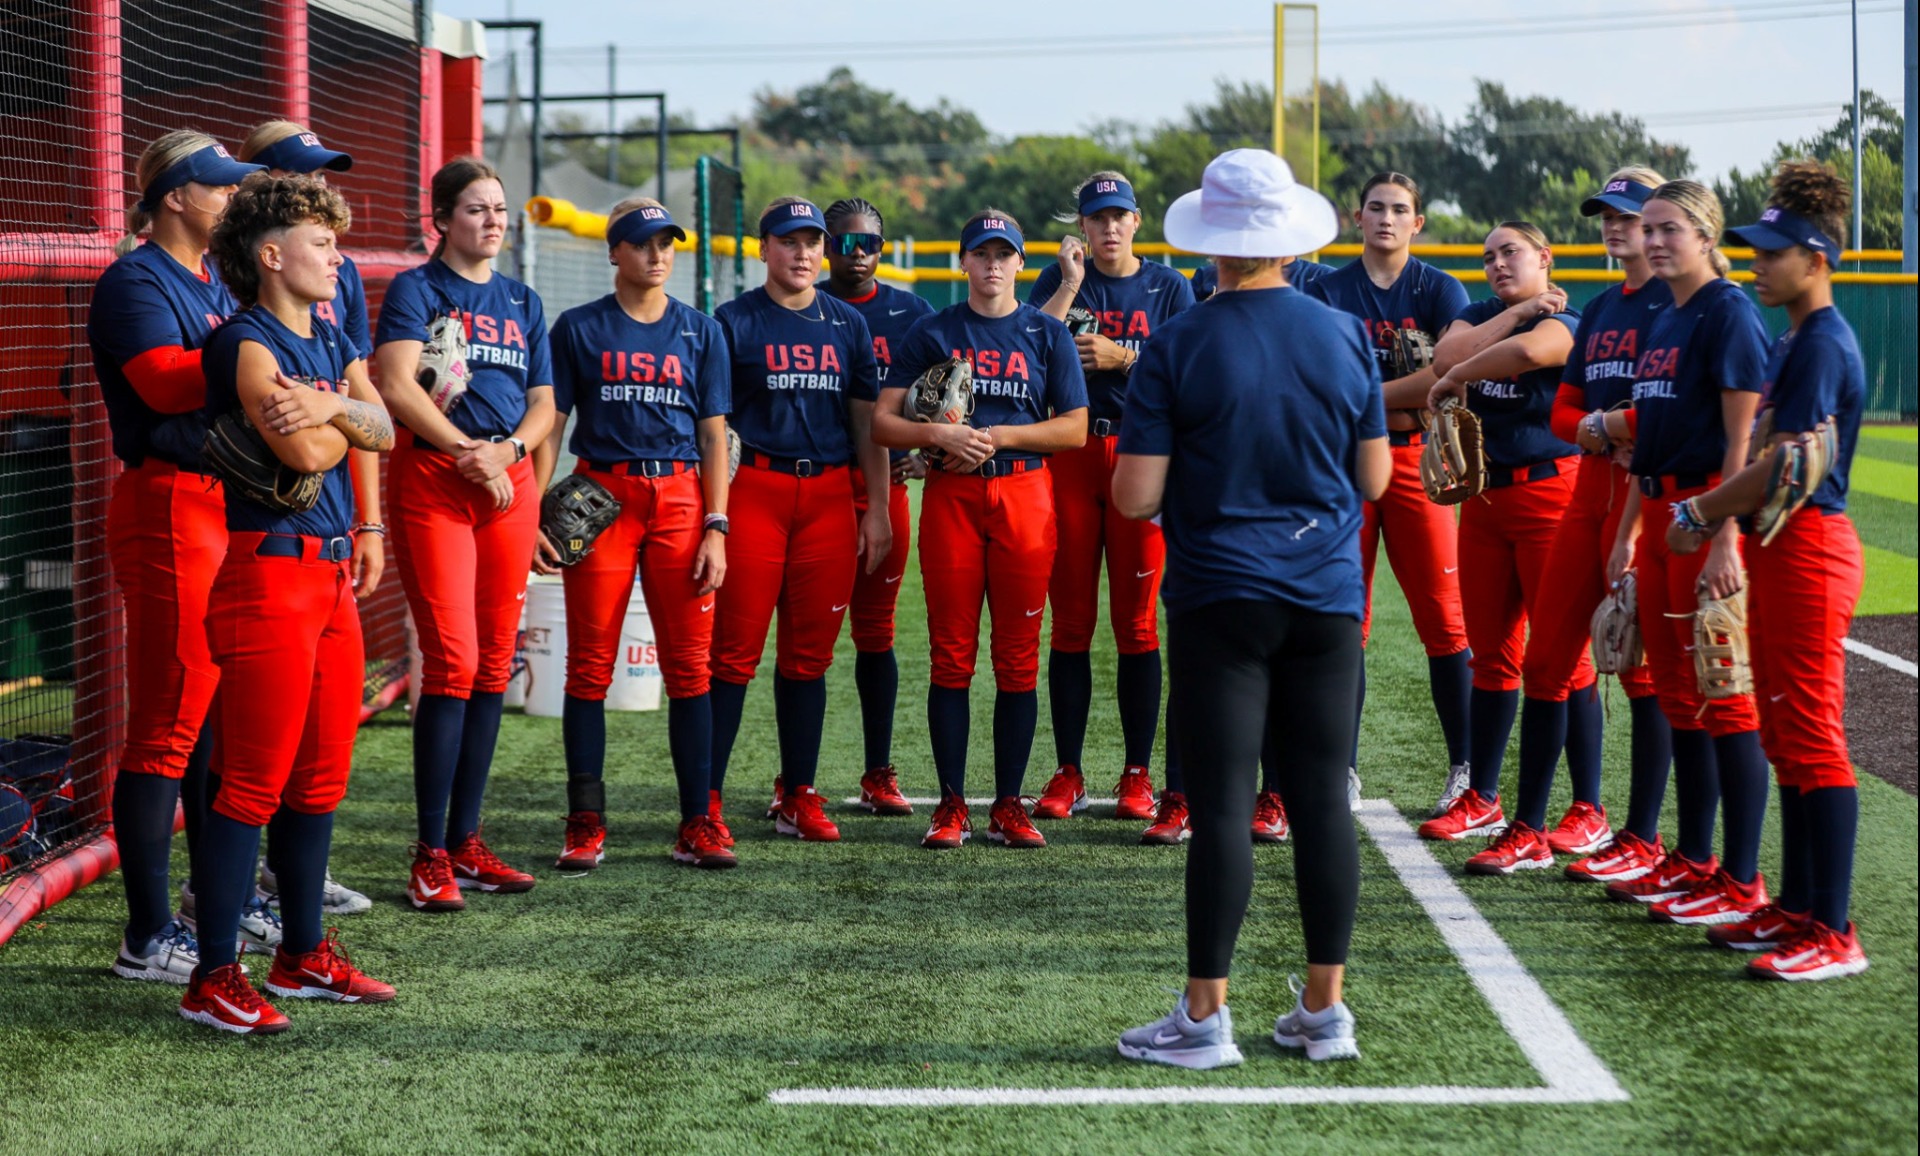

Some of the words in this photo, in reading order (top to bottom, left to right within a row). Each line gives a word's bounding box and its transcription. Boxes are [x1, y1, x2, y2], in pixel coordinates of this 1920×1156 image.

[299, 133, 321, 147] US
[213, 145, 231, 158] US
[1097, 181, 1118, 193] USA
[641, 208, 665, 220] USA
[790, 205, 813, 217] USA
[1761, 208, 1780, 222] SA
[983, 219, 1006, 230] USA
[1585, 328, 1638, 362] USA
[465, 344, 527, 370] FTBALL
[765, 344, 841, 372] USA
[601, 351, 683, 387] USA
[766, 374, 841, 391] SOFTBALL
[972, 378, 1028, 399] FTBALL
[601, 385, 681, 406] SOFTBALL
[627, 645, 656, 665] US
